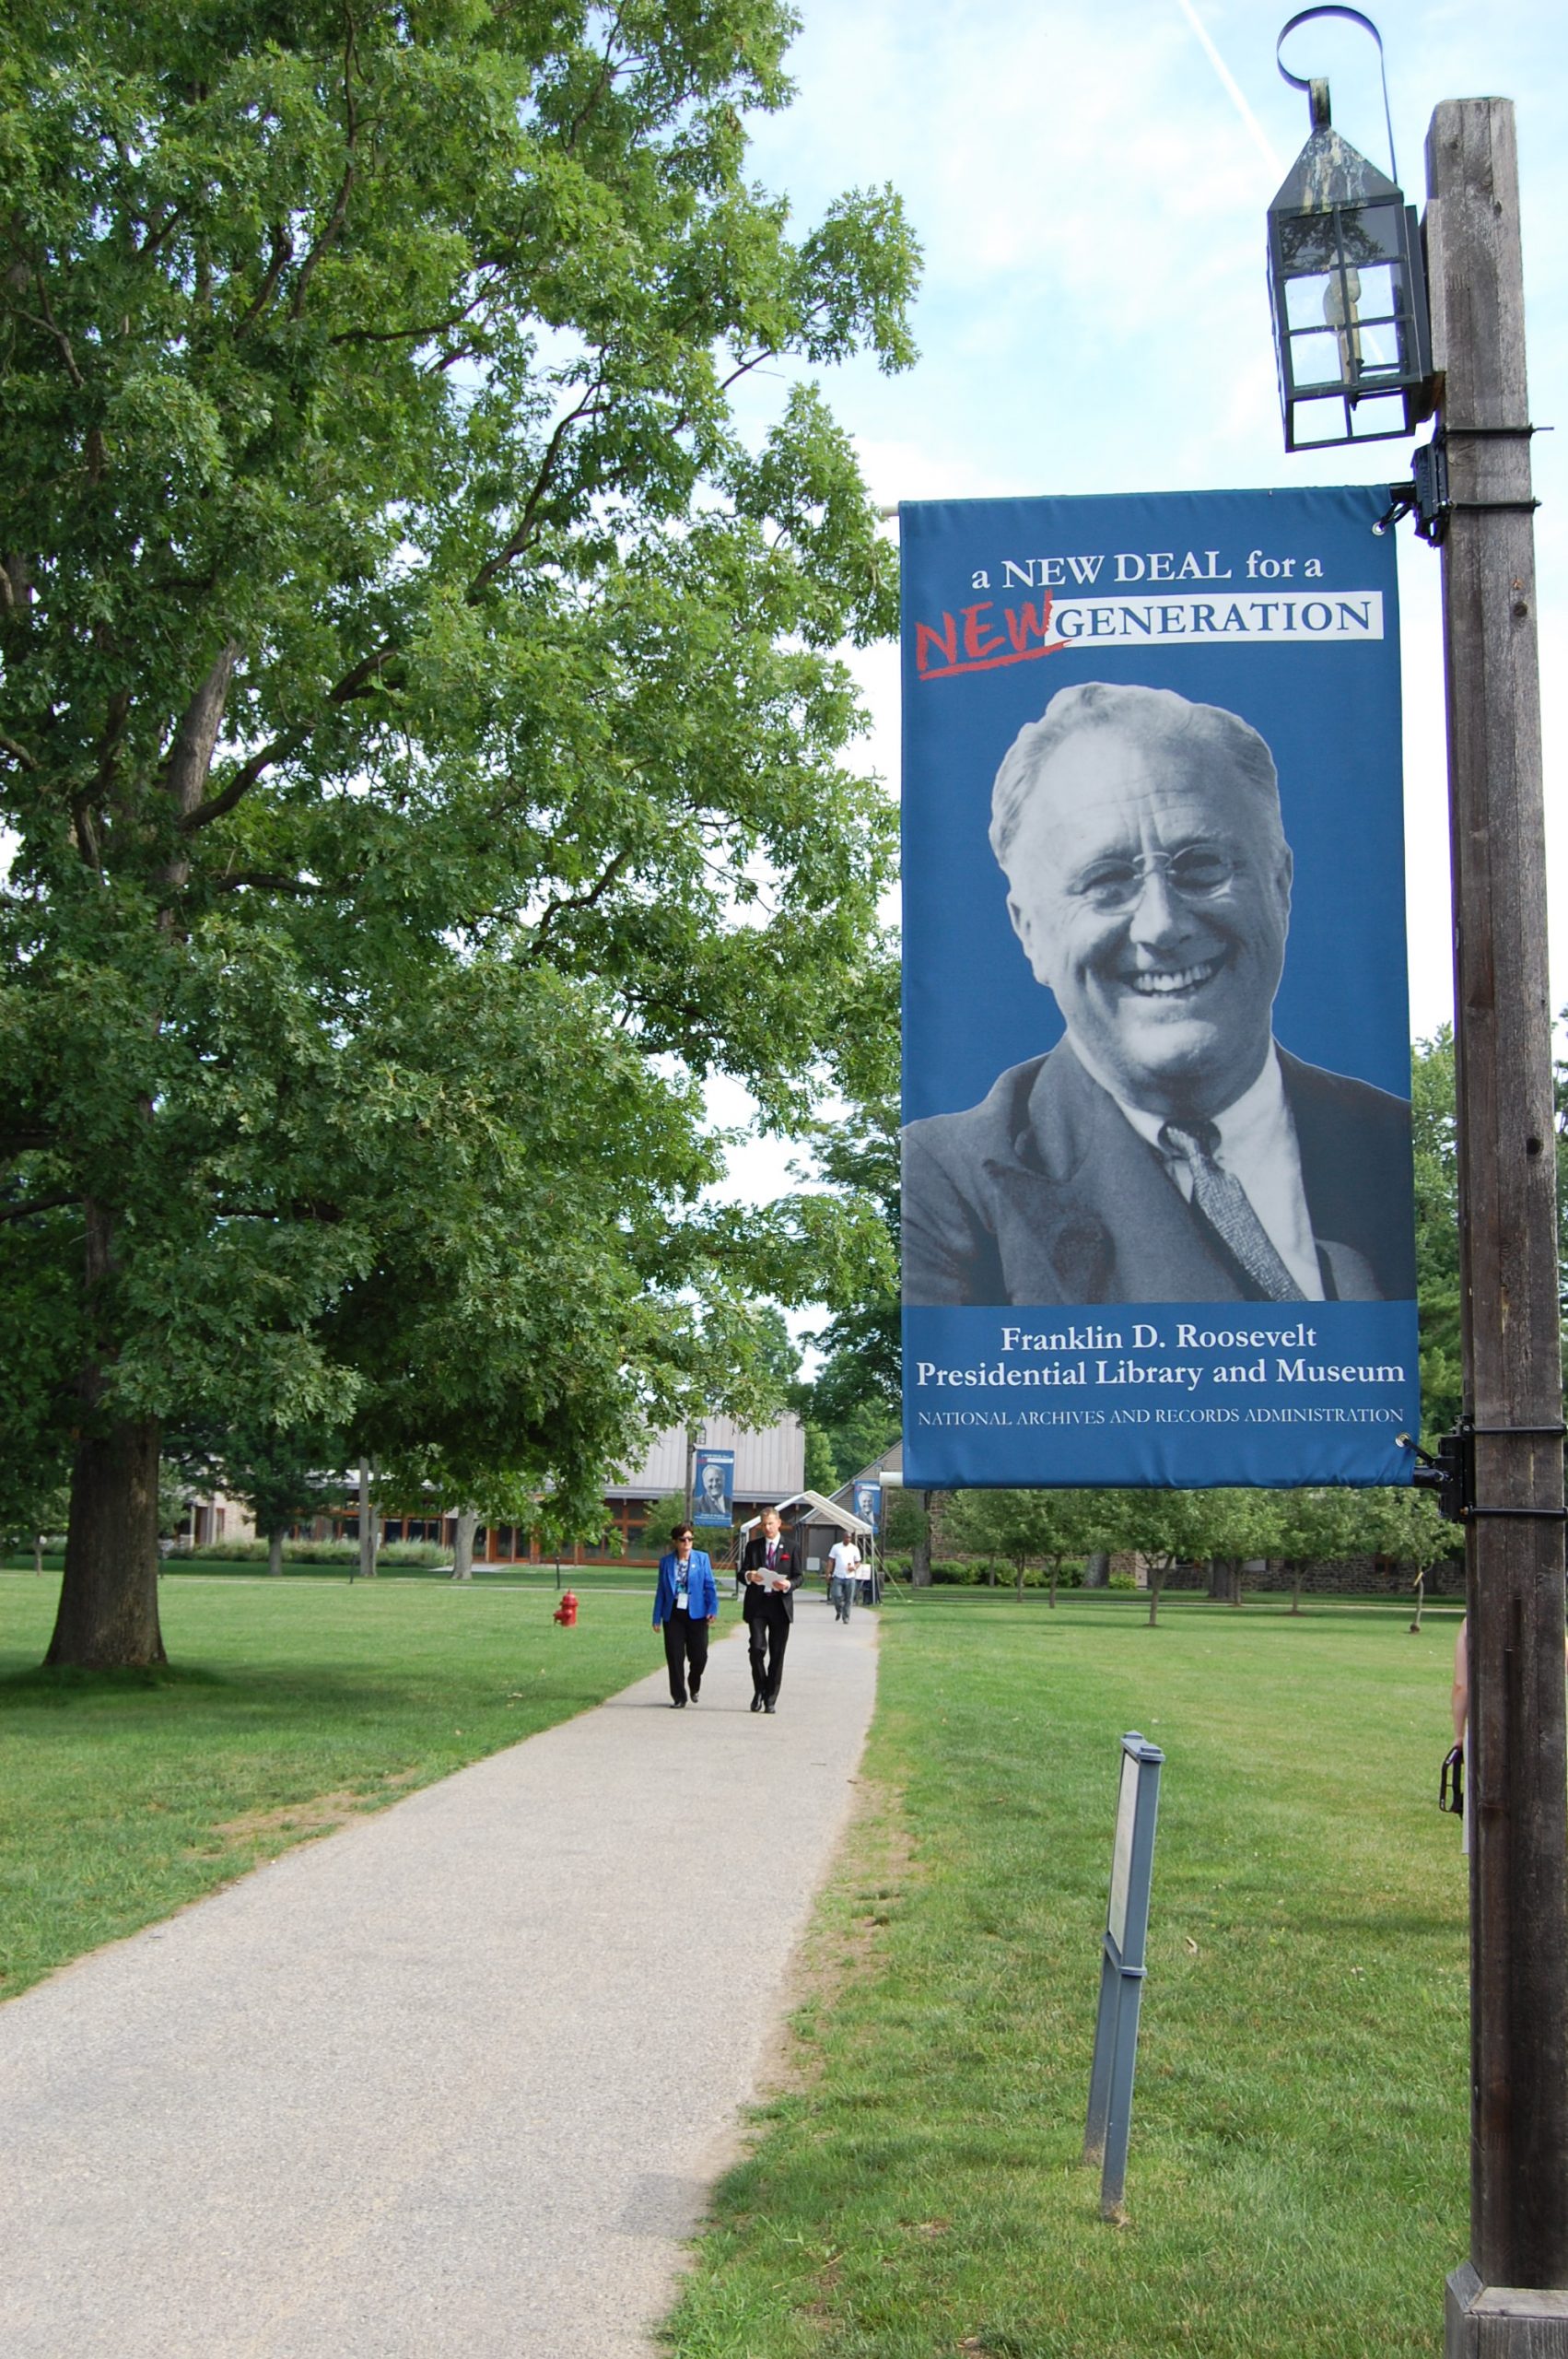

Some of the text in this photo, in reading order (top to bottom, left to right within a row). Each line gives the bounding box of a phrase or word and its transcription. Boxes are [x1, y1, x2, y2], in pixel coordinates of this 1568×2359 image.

[971, 549, 1323, 588] a NEW DEAL for a
[914, 588, 1371, 674] NEW GENERATION
[1001, 1323, 1316, 1350] Franklin D. Roosevelt
[917, 1358, 1404, 1391] Presidential Library and Museum
[919, 1408, 1402, 1425] NATIONAL ARCHIVES AND RECORDS ADMINISTRATION
